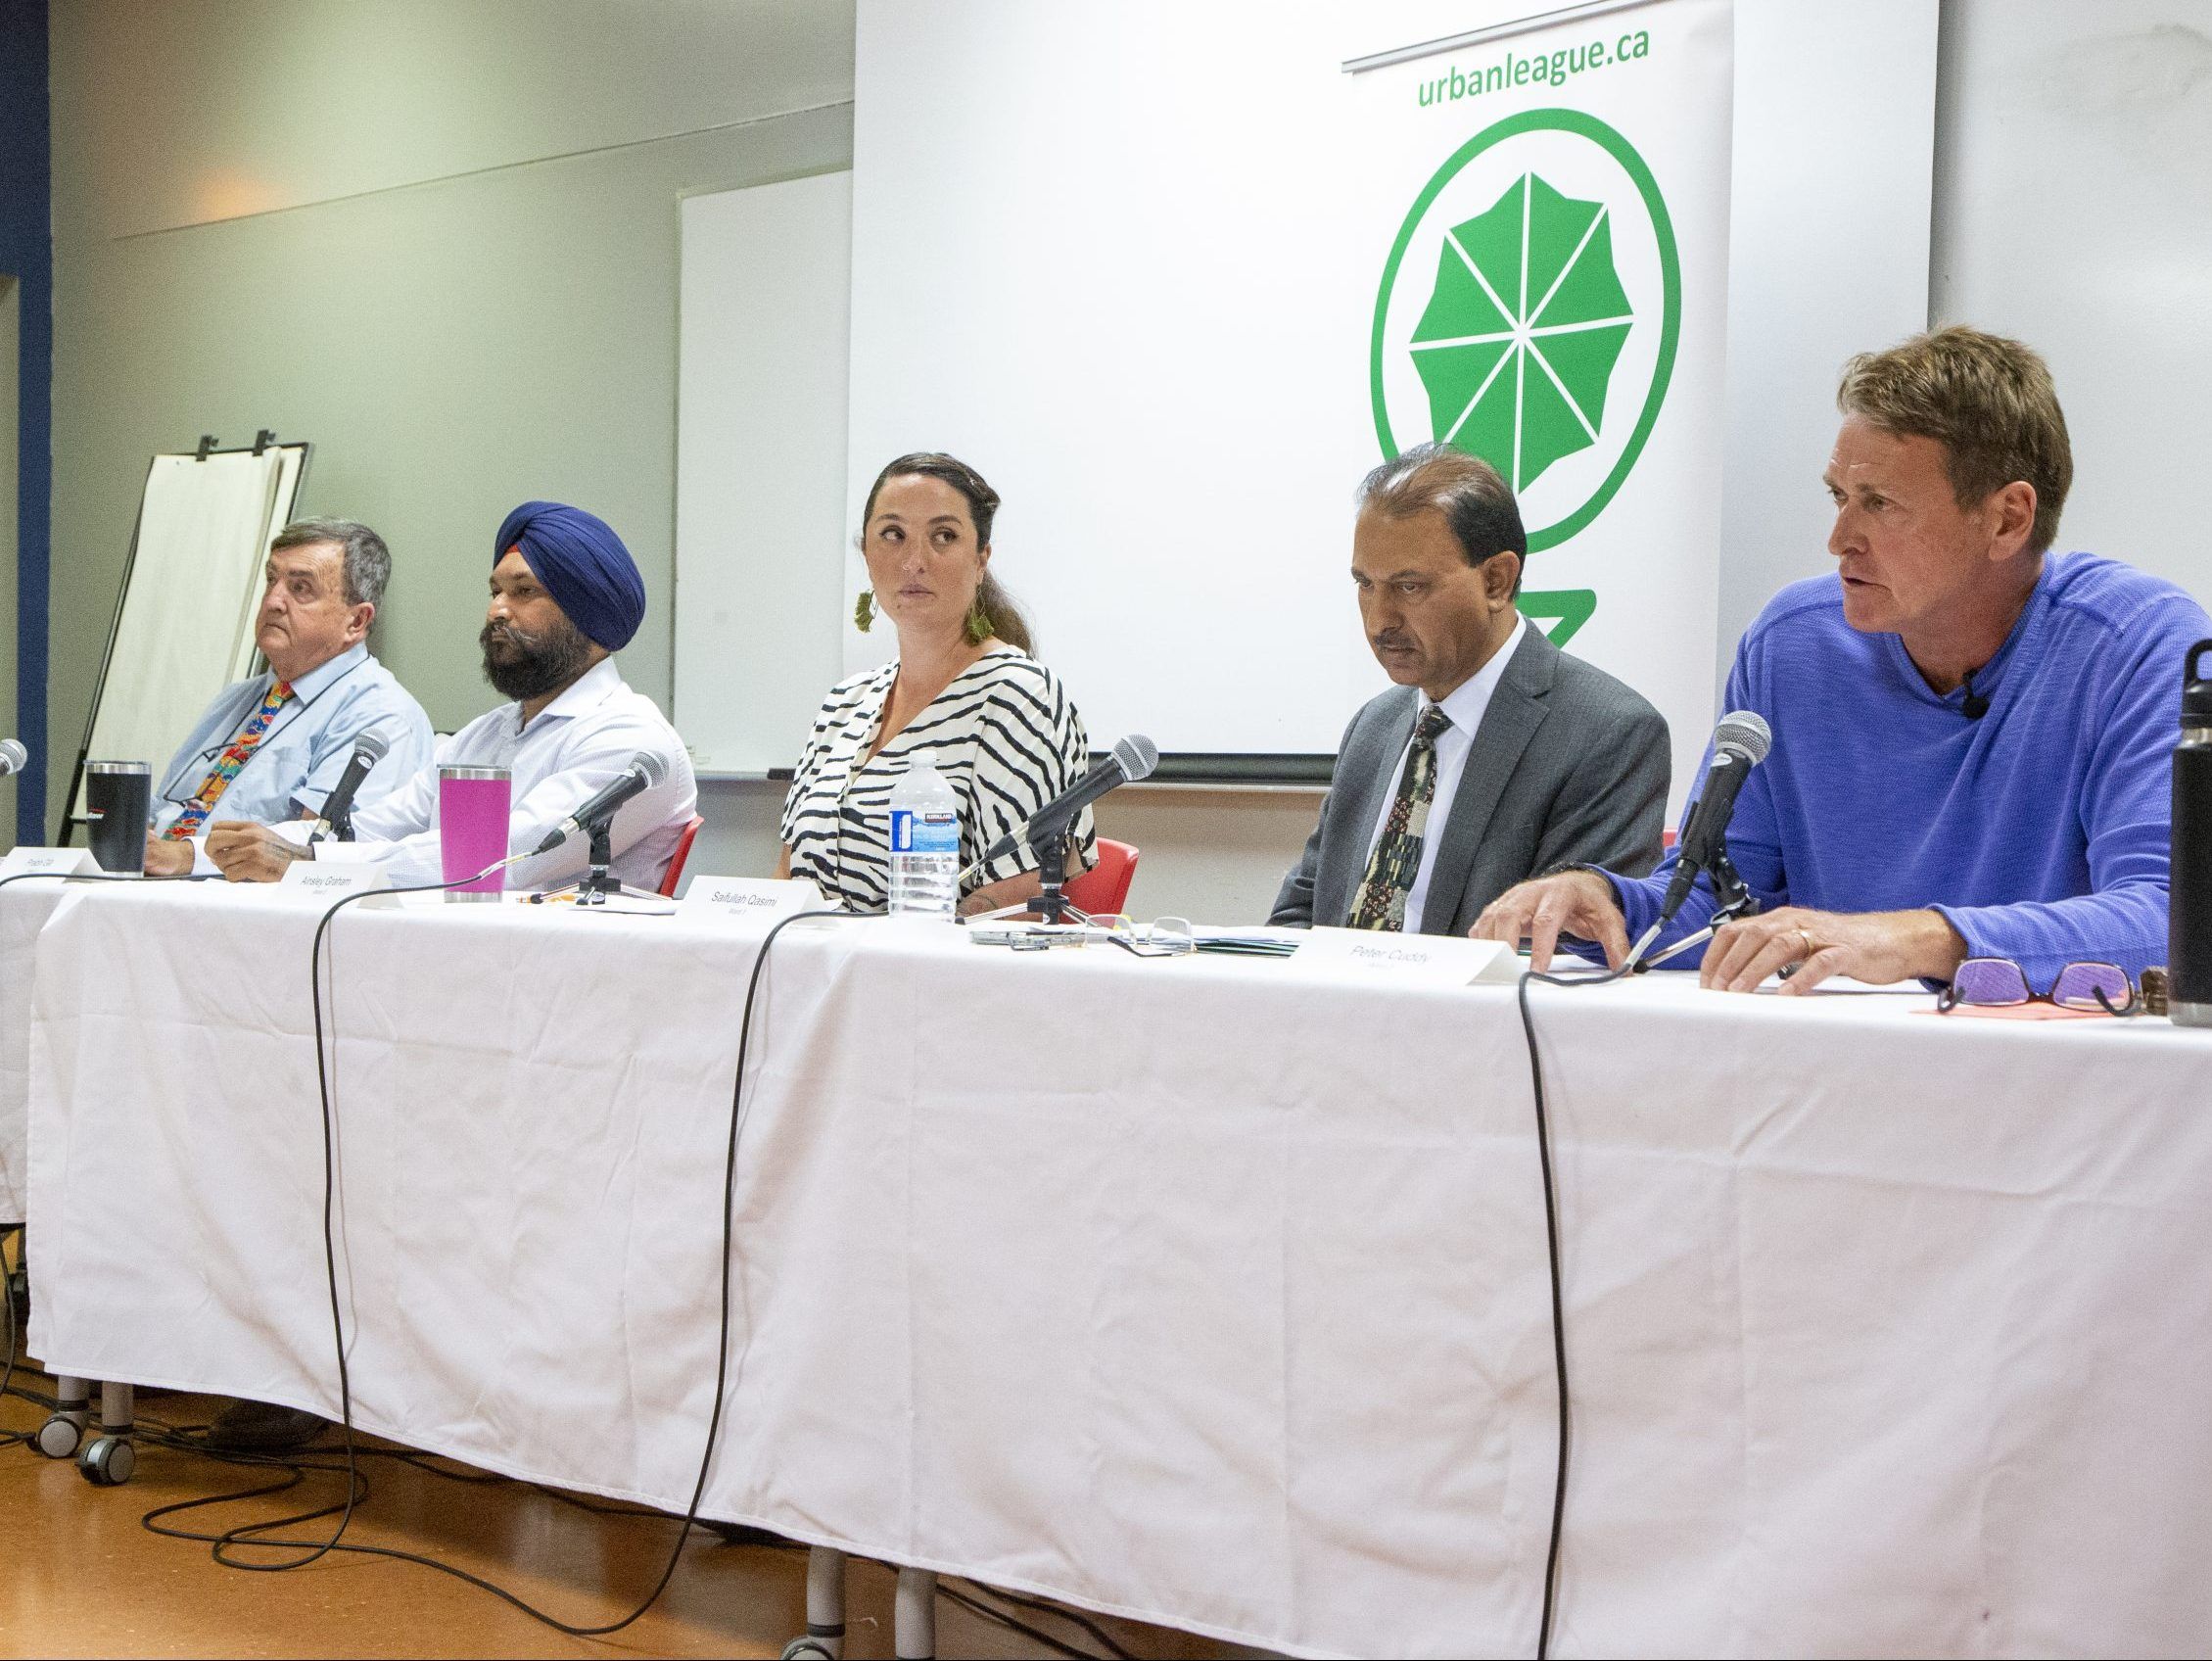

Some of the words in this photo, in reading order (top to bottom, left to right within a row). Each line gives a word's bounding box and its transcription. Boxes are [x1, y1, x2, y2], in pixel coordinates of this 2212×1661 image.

[1419, 29, 1649, 108] urbanleague.ca
[300, 876, 324, 887] Ainsley
[324, 876, 353, 886] Graham
[711, 890, 747, 904] Saifullah
[747, 894, 777, 908] Qasimi
[1349, 944, 1386, 959] Peter
[1388, 949, 1432, 965] Cuddy
